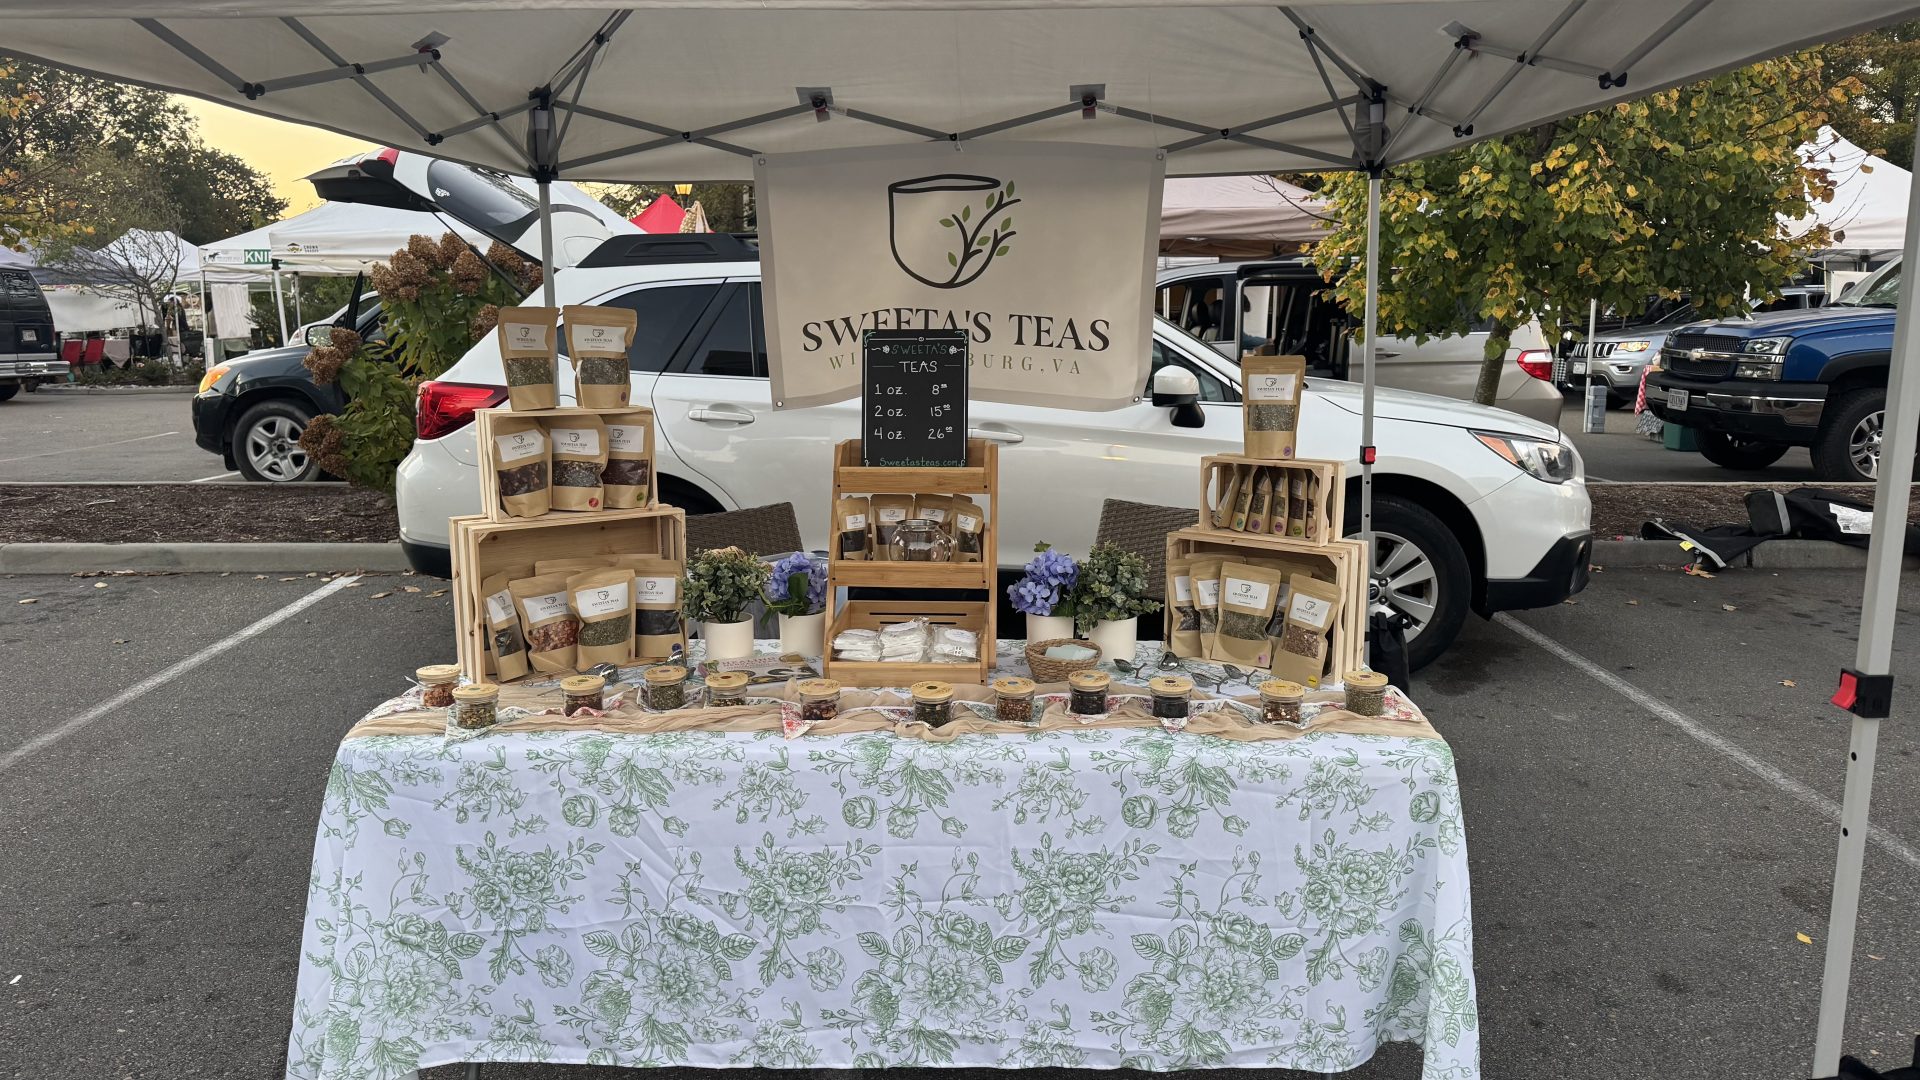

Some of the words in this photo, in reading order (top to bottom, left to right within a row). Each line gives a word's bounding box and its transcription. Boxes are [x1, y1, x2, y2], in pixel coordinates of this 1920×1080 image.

[245, 251, 271, 262] KNI
[802, 308, 992, 352] SWEETA'S
[1008, 314, 1110, 352] TEAS
[892, 344, 947, 355] SWEETA'S
[898, 360, 938, 373] TEAS
[874, 383, 882, 395] 1
[874, 405, 883, 417] 2
[874, 426, 883, 440] 4
